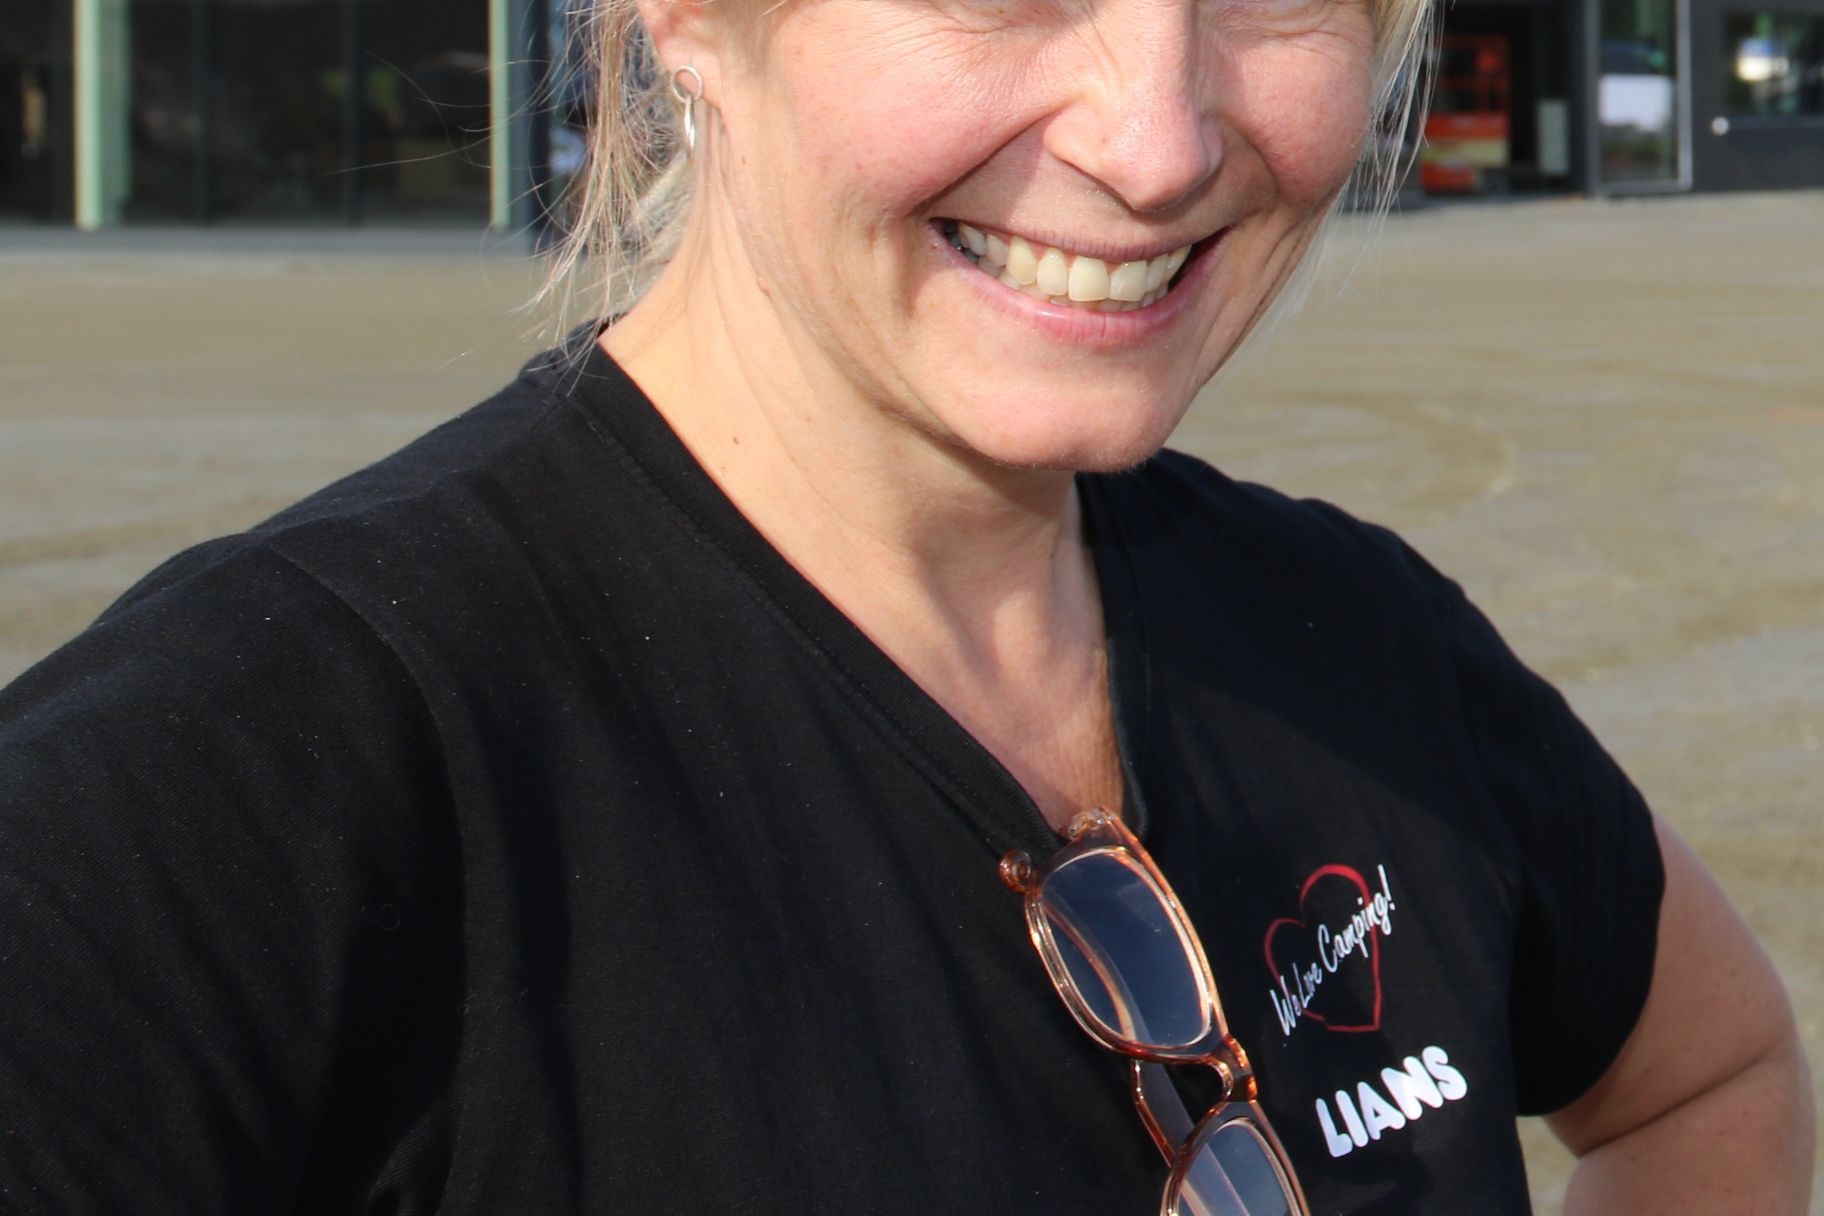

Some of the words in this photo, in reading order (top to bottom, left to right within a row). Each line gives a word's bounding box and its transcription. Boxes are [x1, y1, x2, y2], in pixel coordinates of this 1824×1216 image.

[1270, 975, 1302, 1036] We
[1292, 962, 1323, 1009] Love
[1317, 864, 1396, 973] Camping!
[1315, 1046, 1468, 1158] LIANS
